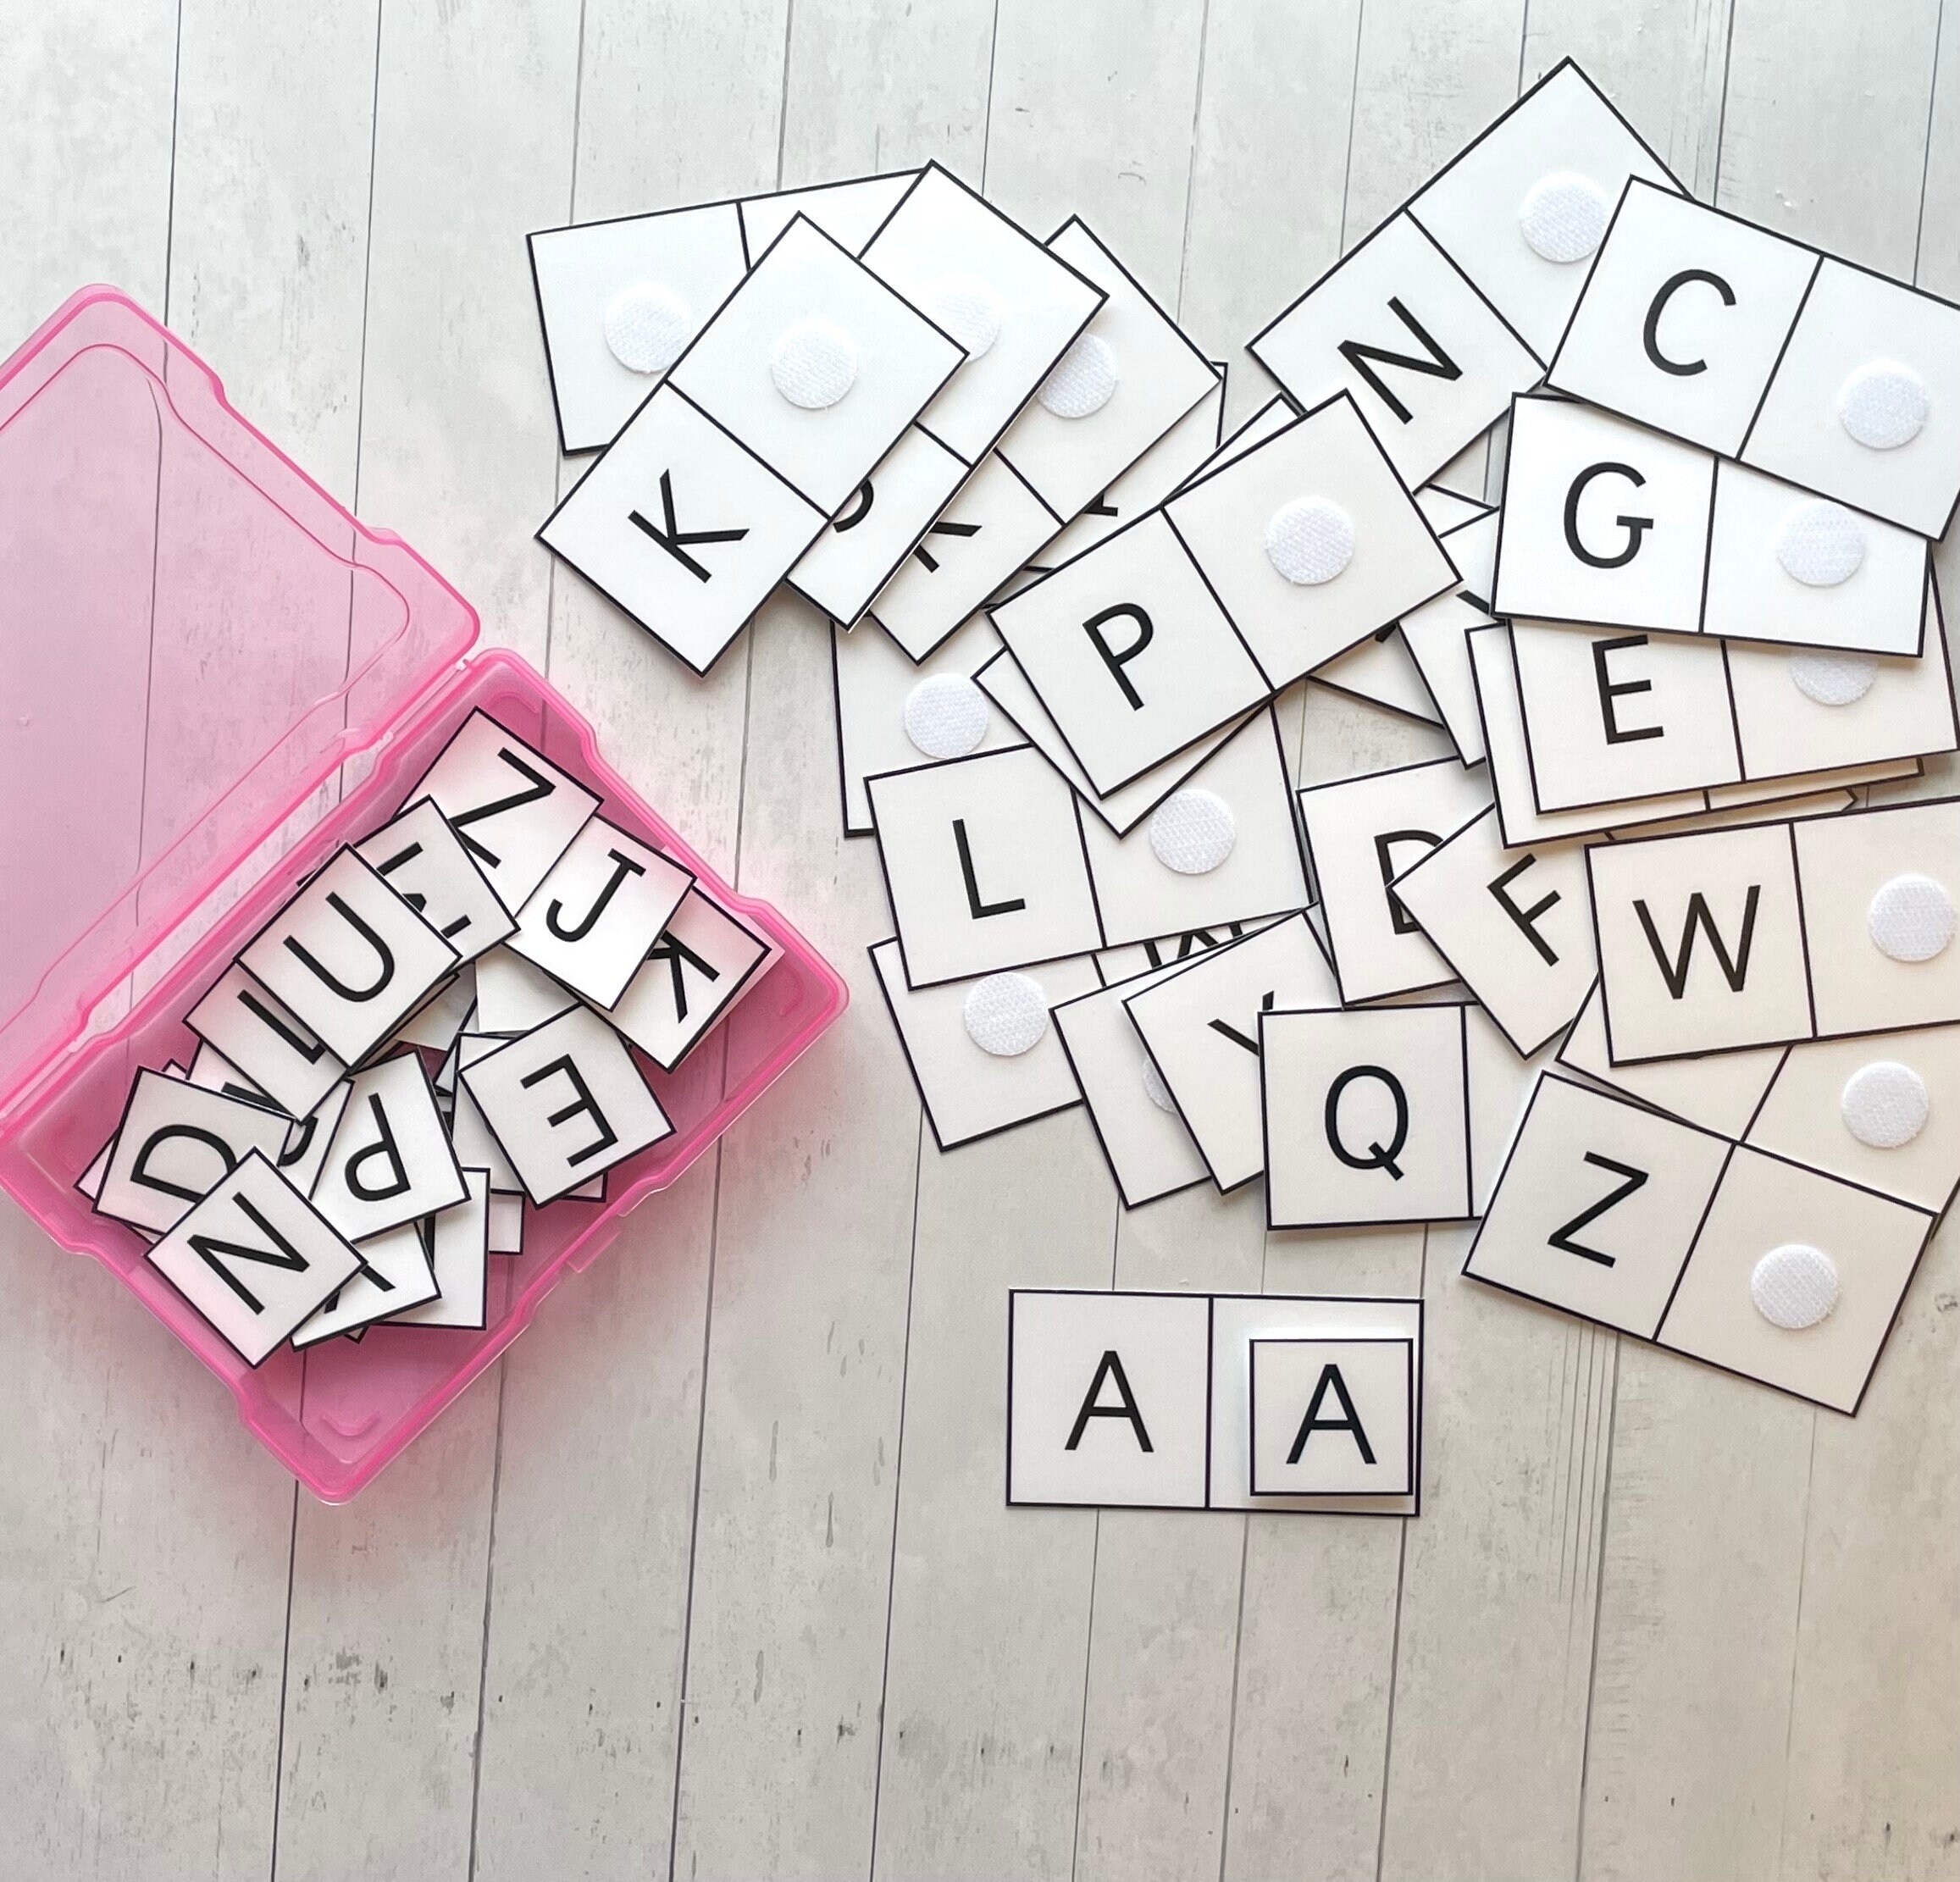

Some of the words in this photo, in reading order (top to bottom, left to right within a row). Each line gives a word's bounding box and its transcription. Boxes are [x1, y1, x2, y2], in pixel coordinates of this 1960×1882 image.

[1337, 296, 1464, 425] N
[1643, 268, 1737, 376] C
[627, 468, 750, 584] K
[1564, 462, 1654, 569] G
[1082, 602, 1154, 711] P
[1592, 633, 1665, 745] E
[545, 848, 647, 943] J
[952, 818, 1027, 920] L
[1487, 853, 1562, 967] F
[283, 891, 396, 1003] U
[1632, 884, 1762, 1000] W
[345, 1093, 412, 1202] P
[520, 1053, 618, 1168] E
[1325, 1065, 1409, 1182] Q
[186, 1192, 311, 1315] N
[1547, 1150, 1650, 1269] Z
[1064, 1350, 1154, 1453] A
[1286, 1364, 1378, 1465] A
